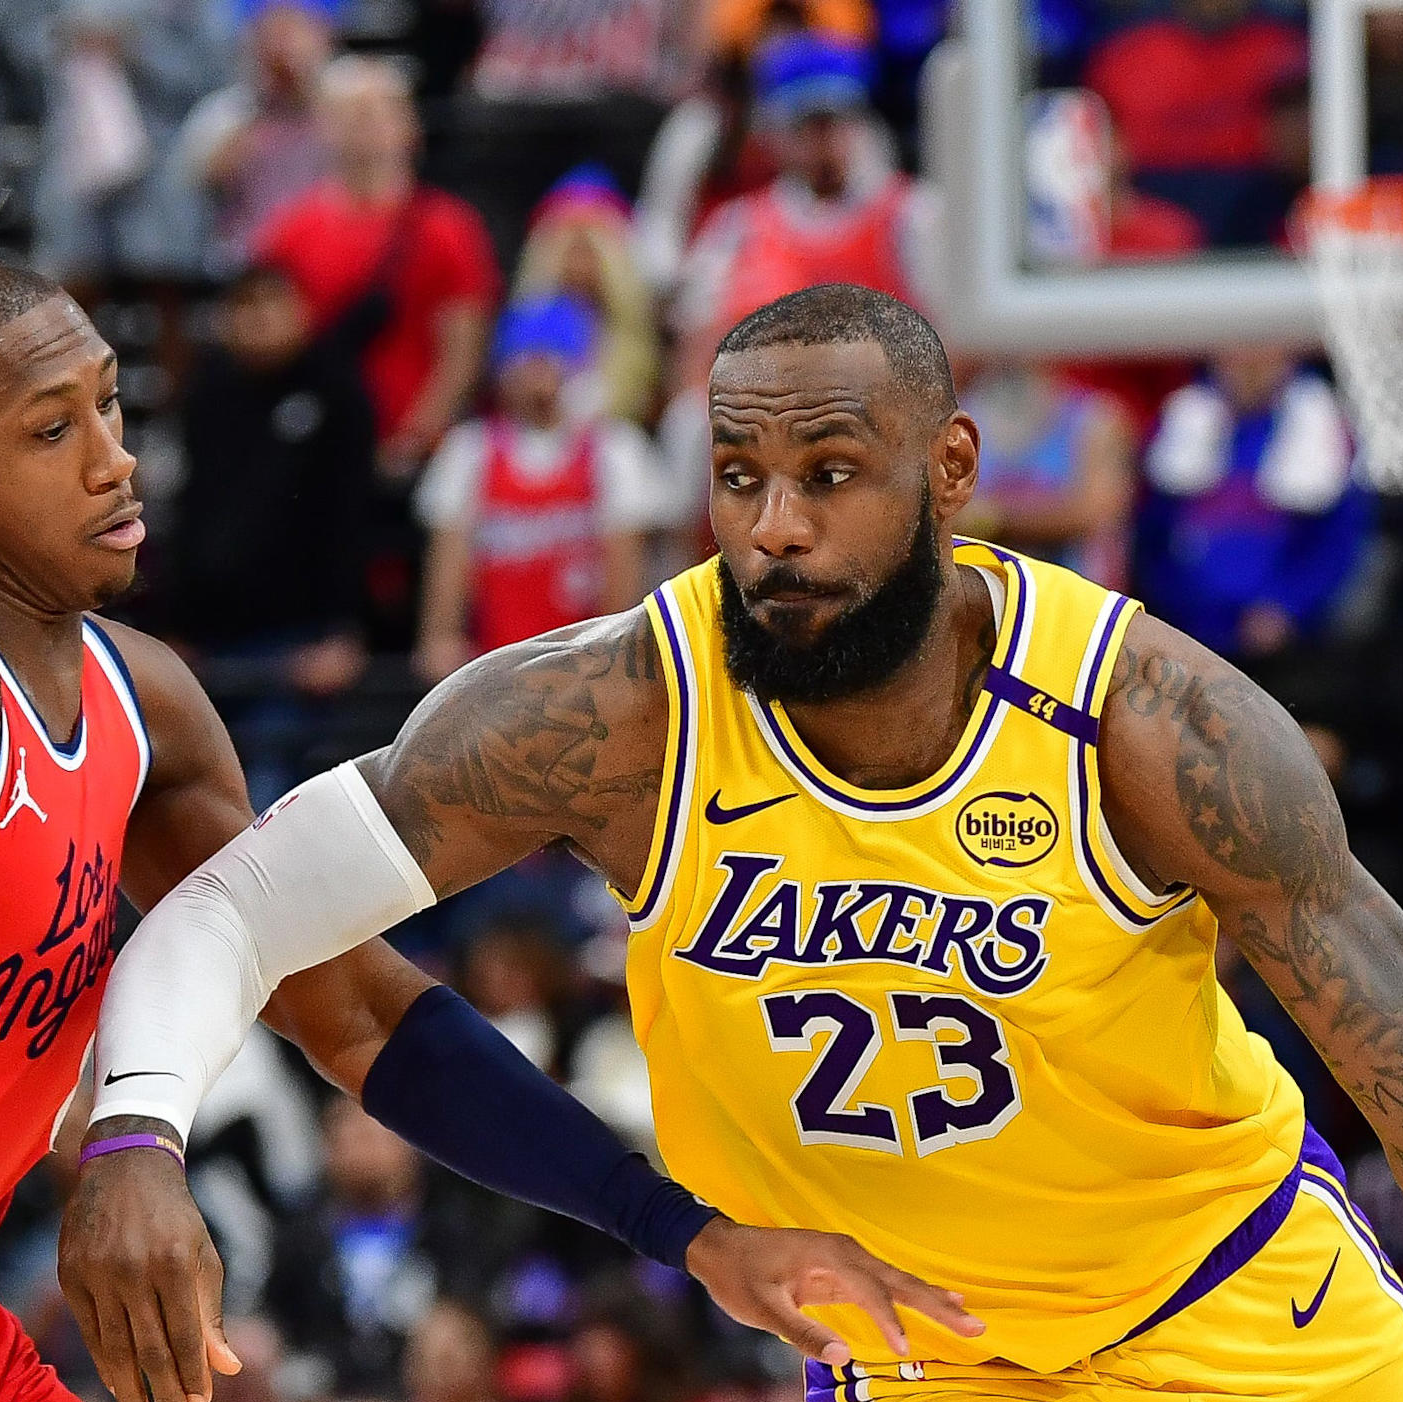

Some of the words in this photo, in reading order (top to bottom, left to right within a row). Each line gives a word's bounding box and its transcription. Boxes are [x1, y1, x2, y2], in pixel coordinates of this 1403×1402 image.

[1027, 691, 1059, 722] 44
[965, 810, 1053, 846] bibigo
[980, 837, 1017, 851] 비비고
[35, 837, 104, 956] Los
[670, 851, 1055, 1000] LAKERS
[757, 988, 1024, 1160] 23
